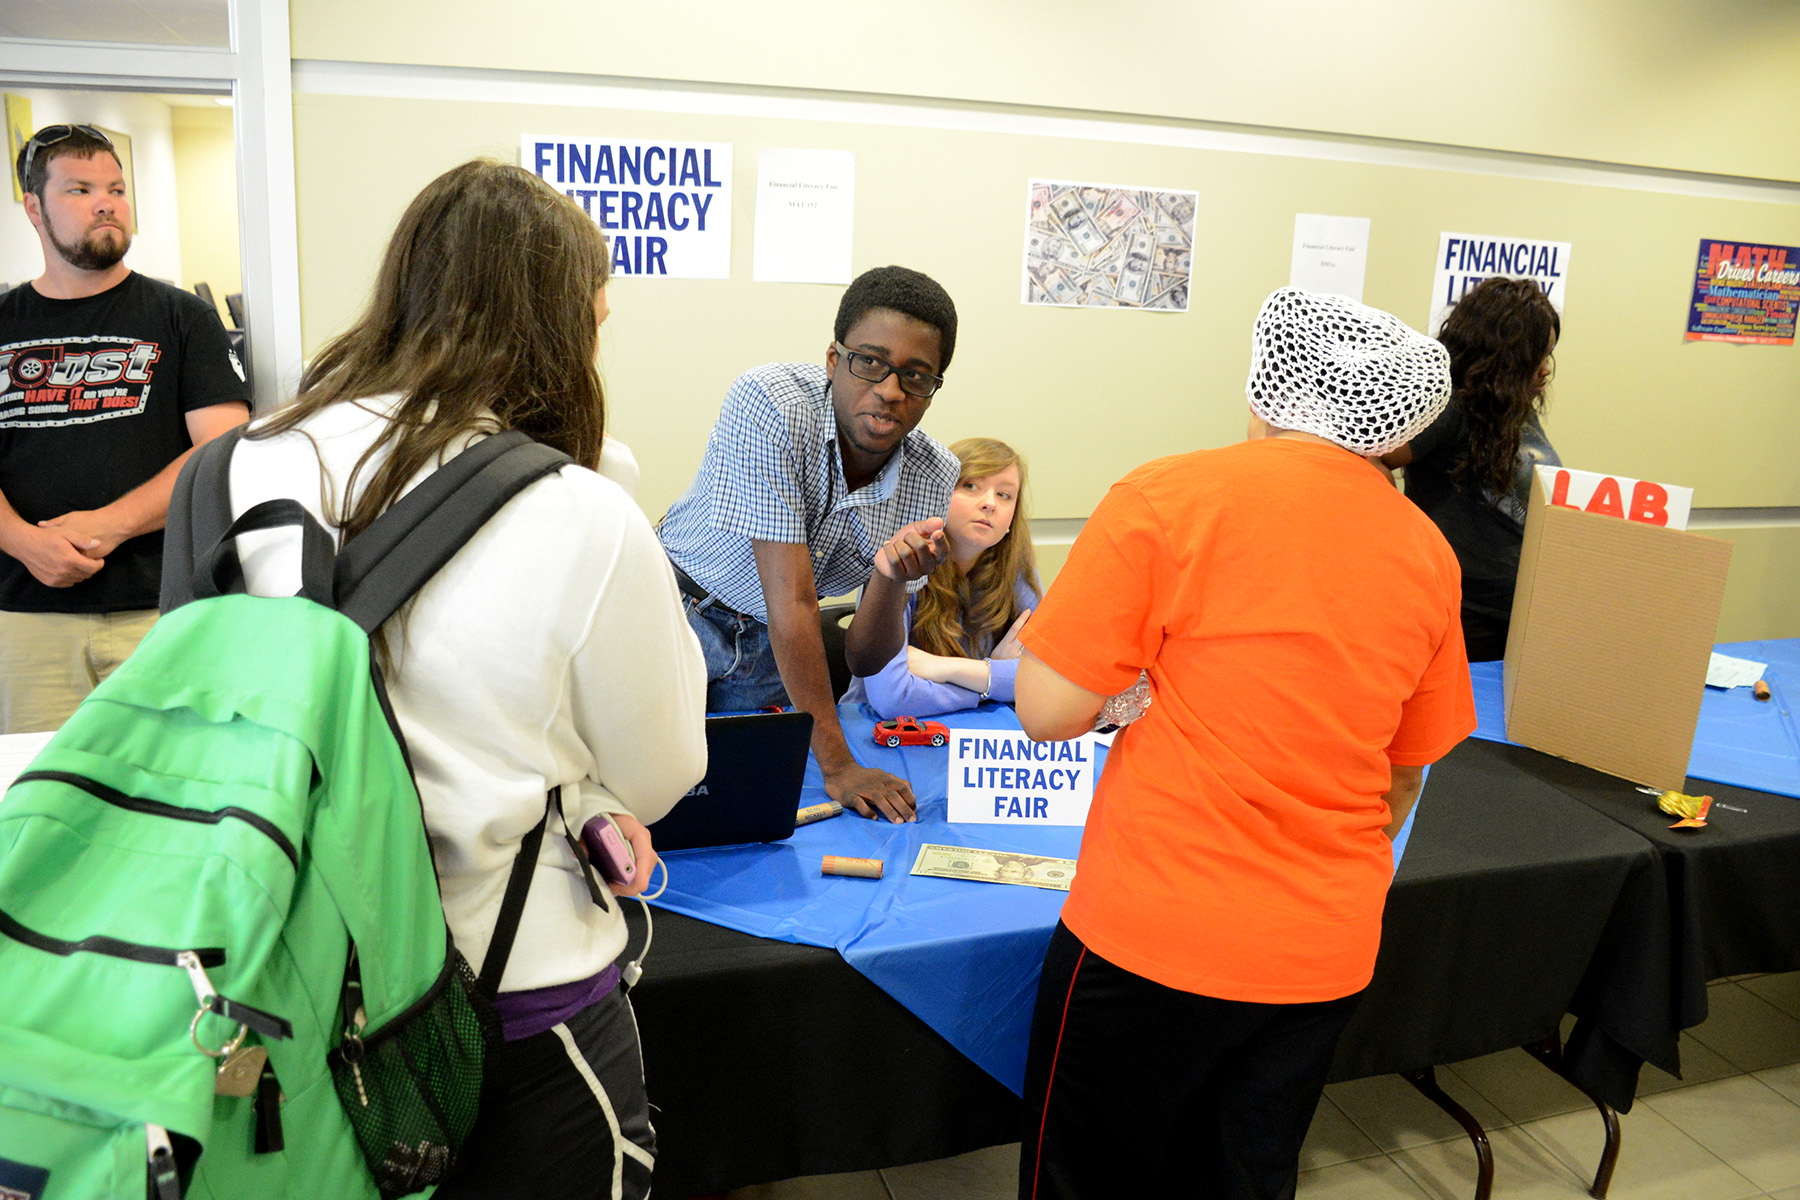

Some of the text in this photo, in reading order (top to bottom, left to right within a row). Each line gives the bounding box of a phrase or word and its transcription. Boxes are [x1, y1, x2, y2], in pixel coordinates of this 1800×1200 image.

[535, 142, 722, 187] FINANCIAL
[566, 189, 713, 231] TERACY
[604, 235, 668, 275] AIR
[1445, 238, 1561, 277] FINANCIAL
[1706, 243, 1787, 277] MATH
[1717, 260, 1756, 281] Drives
[1757, 263, 1800, 285] Careers
[1709, 285, 1779, 300] Mathematician
[24, 389, 66, 403] HAVE
[70, 387, 84, 400] IT
[69, 398, 99, 411] THAT
[102, 396, 139, 408] DOES!
[1551, 470, 1668, 527] LAB
[959, 738, 1087, 762] FINANCIAL
[963, 767, 1081, 790] LITERACY
[994, 796, 1048, 818] FAIR
